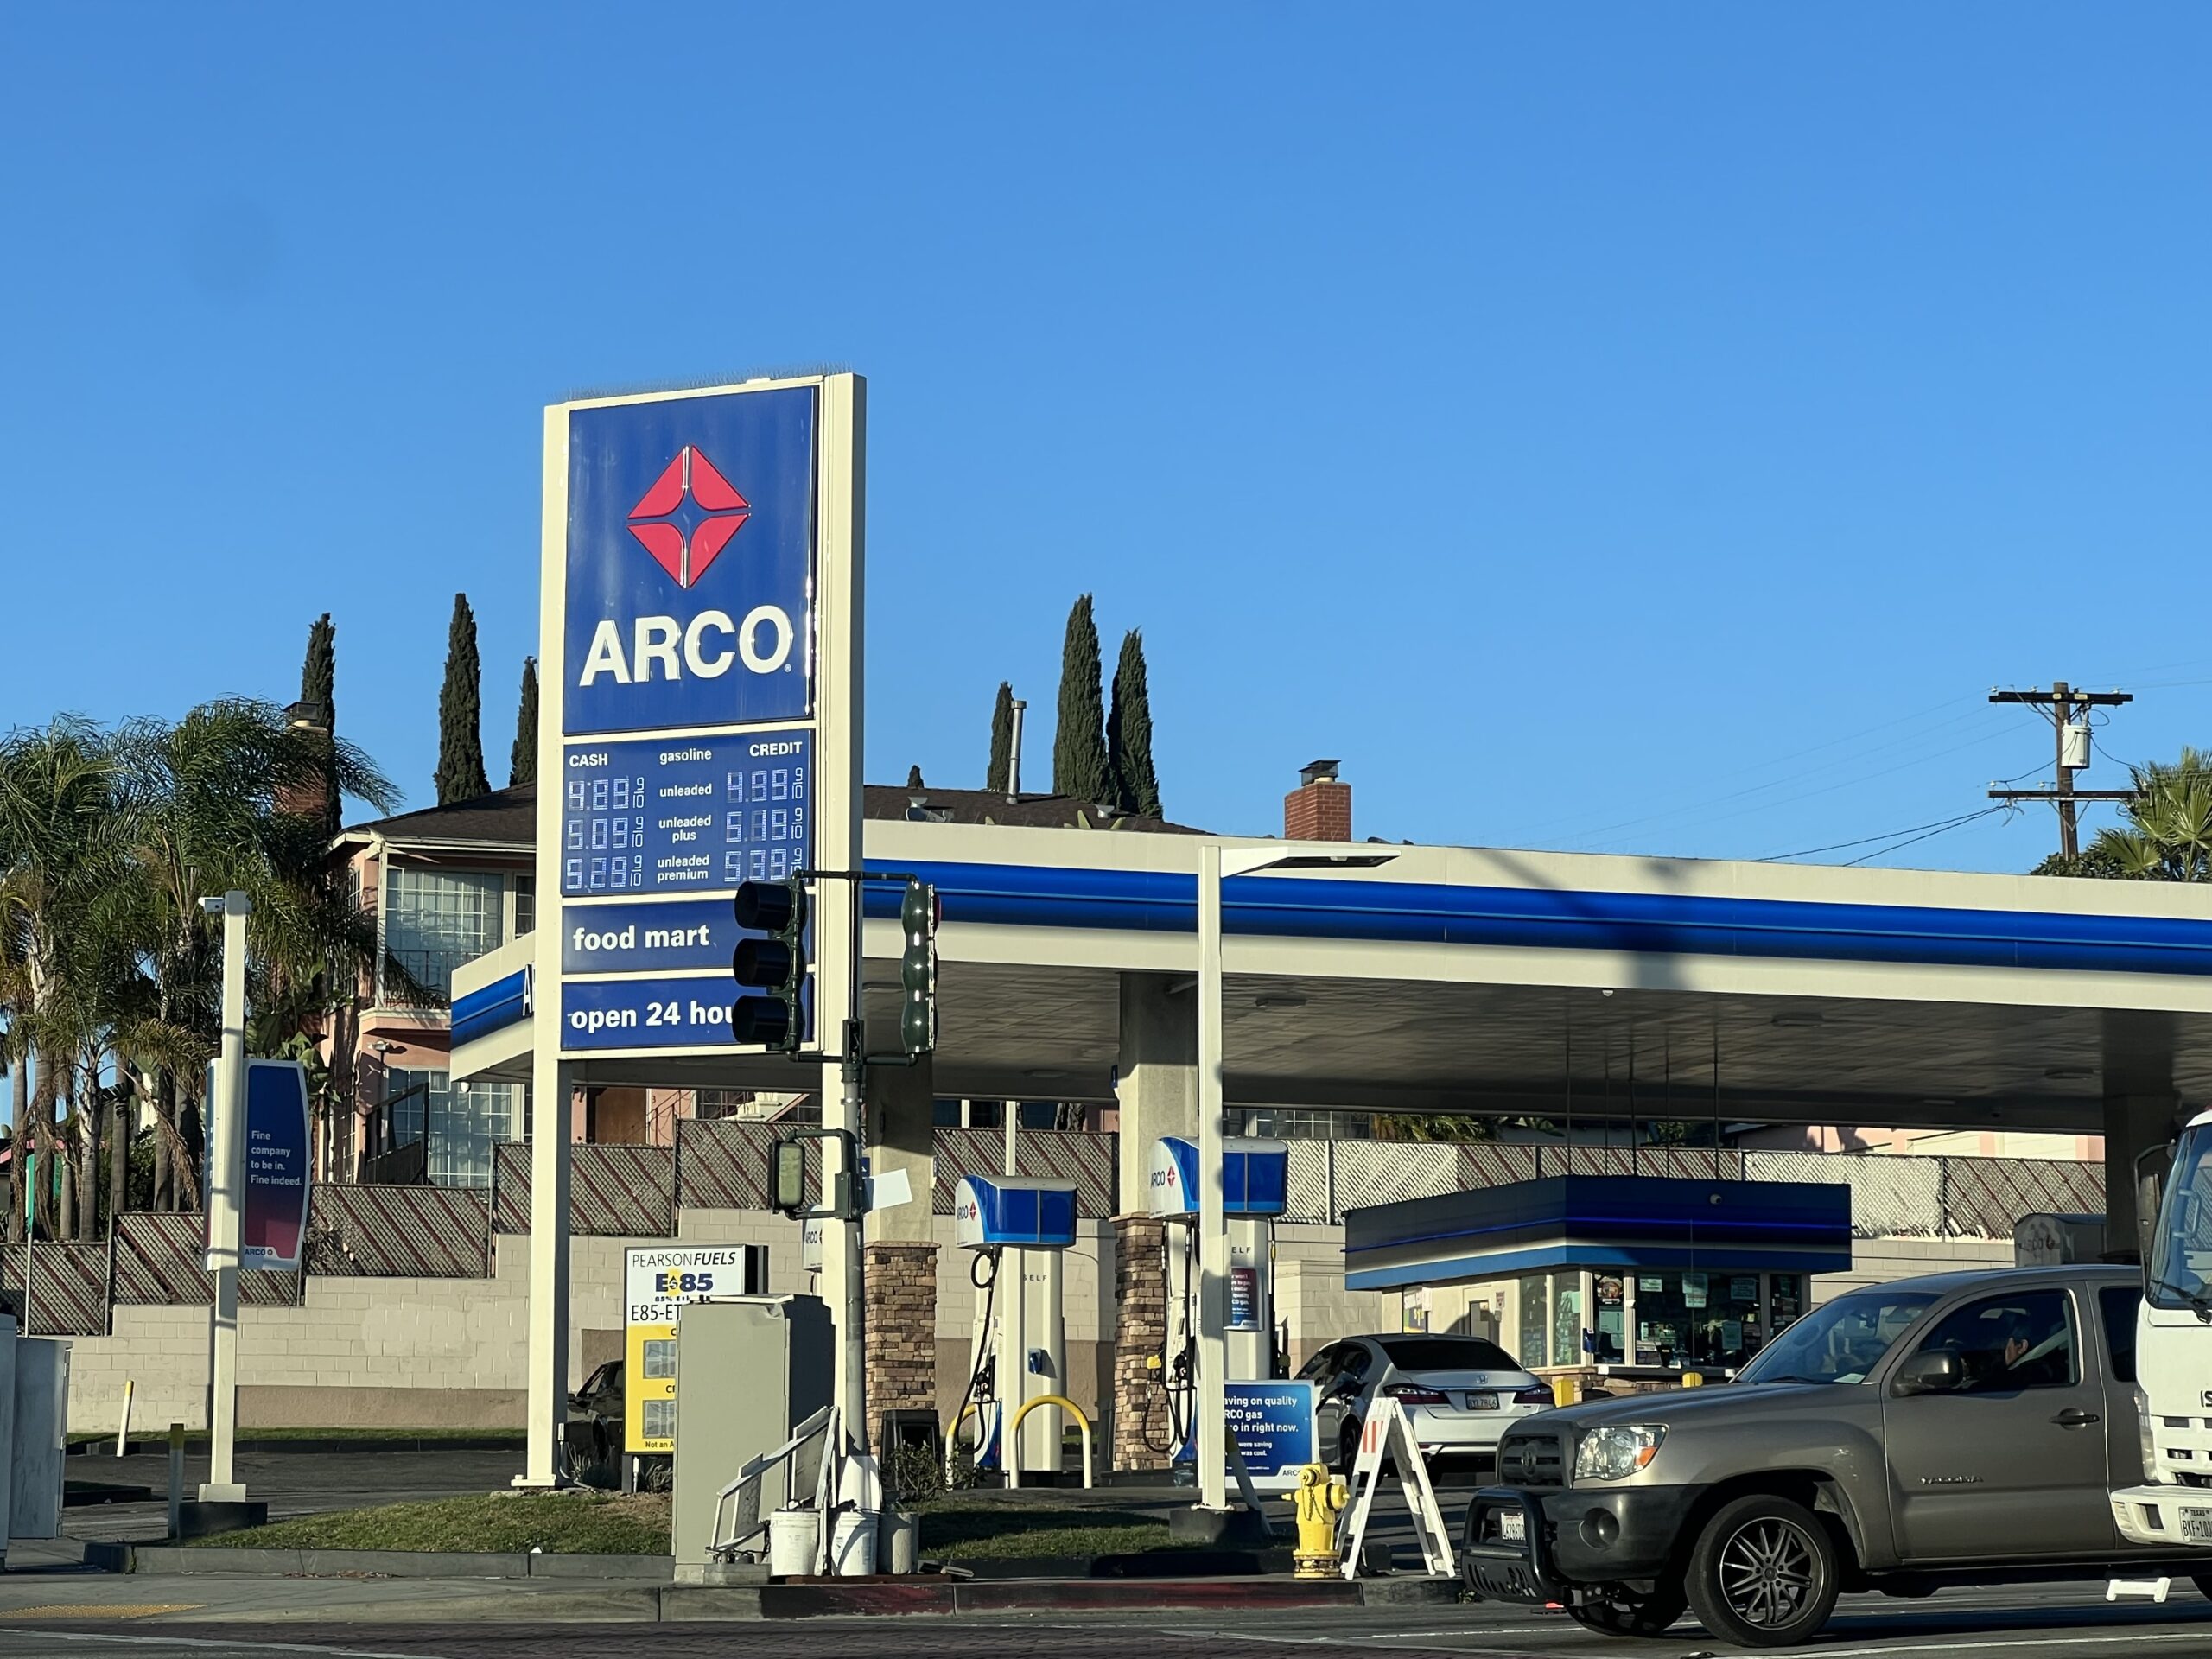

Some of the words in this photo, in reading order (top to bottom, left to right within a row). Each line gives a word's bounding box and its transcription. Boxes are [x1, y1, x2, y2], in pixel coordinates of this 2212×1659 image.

[579, 604, 793, 687] ARCO
[659, 747, 712, 766] gasoline
[749, 741, 803, 757] CREDIT
[569, 753, 608, 767] CASH
[659, 783, 712, 798] unleaded
[727, 768, 788, 803] 4.99
[658, 815, 712, 829] unleaded
[726, 809, 787, 842] 5.19
[567, 817, 629, 850] 5.09
[672, 830, 696, 844] plus
[657, 855, 710, 868] unleaded
[724, 849, 786, 882] 5.39
[566, 856, 627, 890] 5.29
[657, 869, 709, 884] premium
[573, 925, 635, 951] food
[645, 925, 709, 948] mart
[570, 1009, 637, 1034] open
[645, 1002, 681, 1027] 24
[251, 1130, 271, 1141] Fine
[251, 1147, 291, 1158] company
[251, 1160, 260, 1169] to
[262, 1160, 273, 1170] be
[275, 1161, 285, 1171] in.
[251, 1175, 270, 1185] Fine
[271, 1176, 302, 1186] indeed.
[632, 1304, 682, 1321] E85-ET
[1224, 1396, 1249, 1407] aving
[1250, 1397, 1262, 1406] on
[1264, 1395, 1297, 1408] quality
[1224, 1409, 1243, 1420] RCO
[1245, 1410, 1263, 1421] gas
[1241, 1422, 1249, 1432] in
[1252, 1422, 1274, 1434] right
[1276, 1424, 1299, 1433] now.
